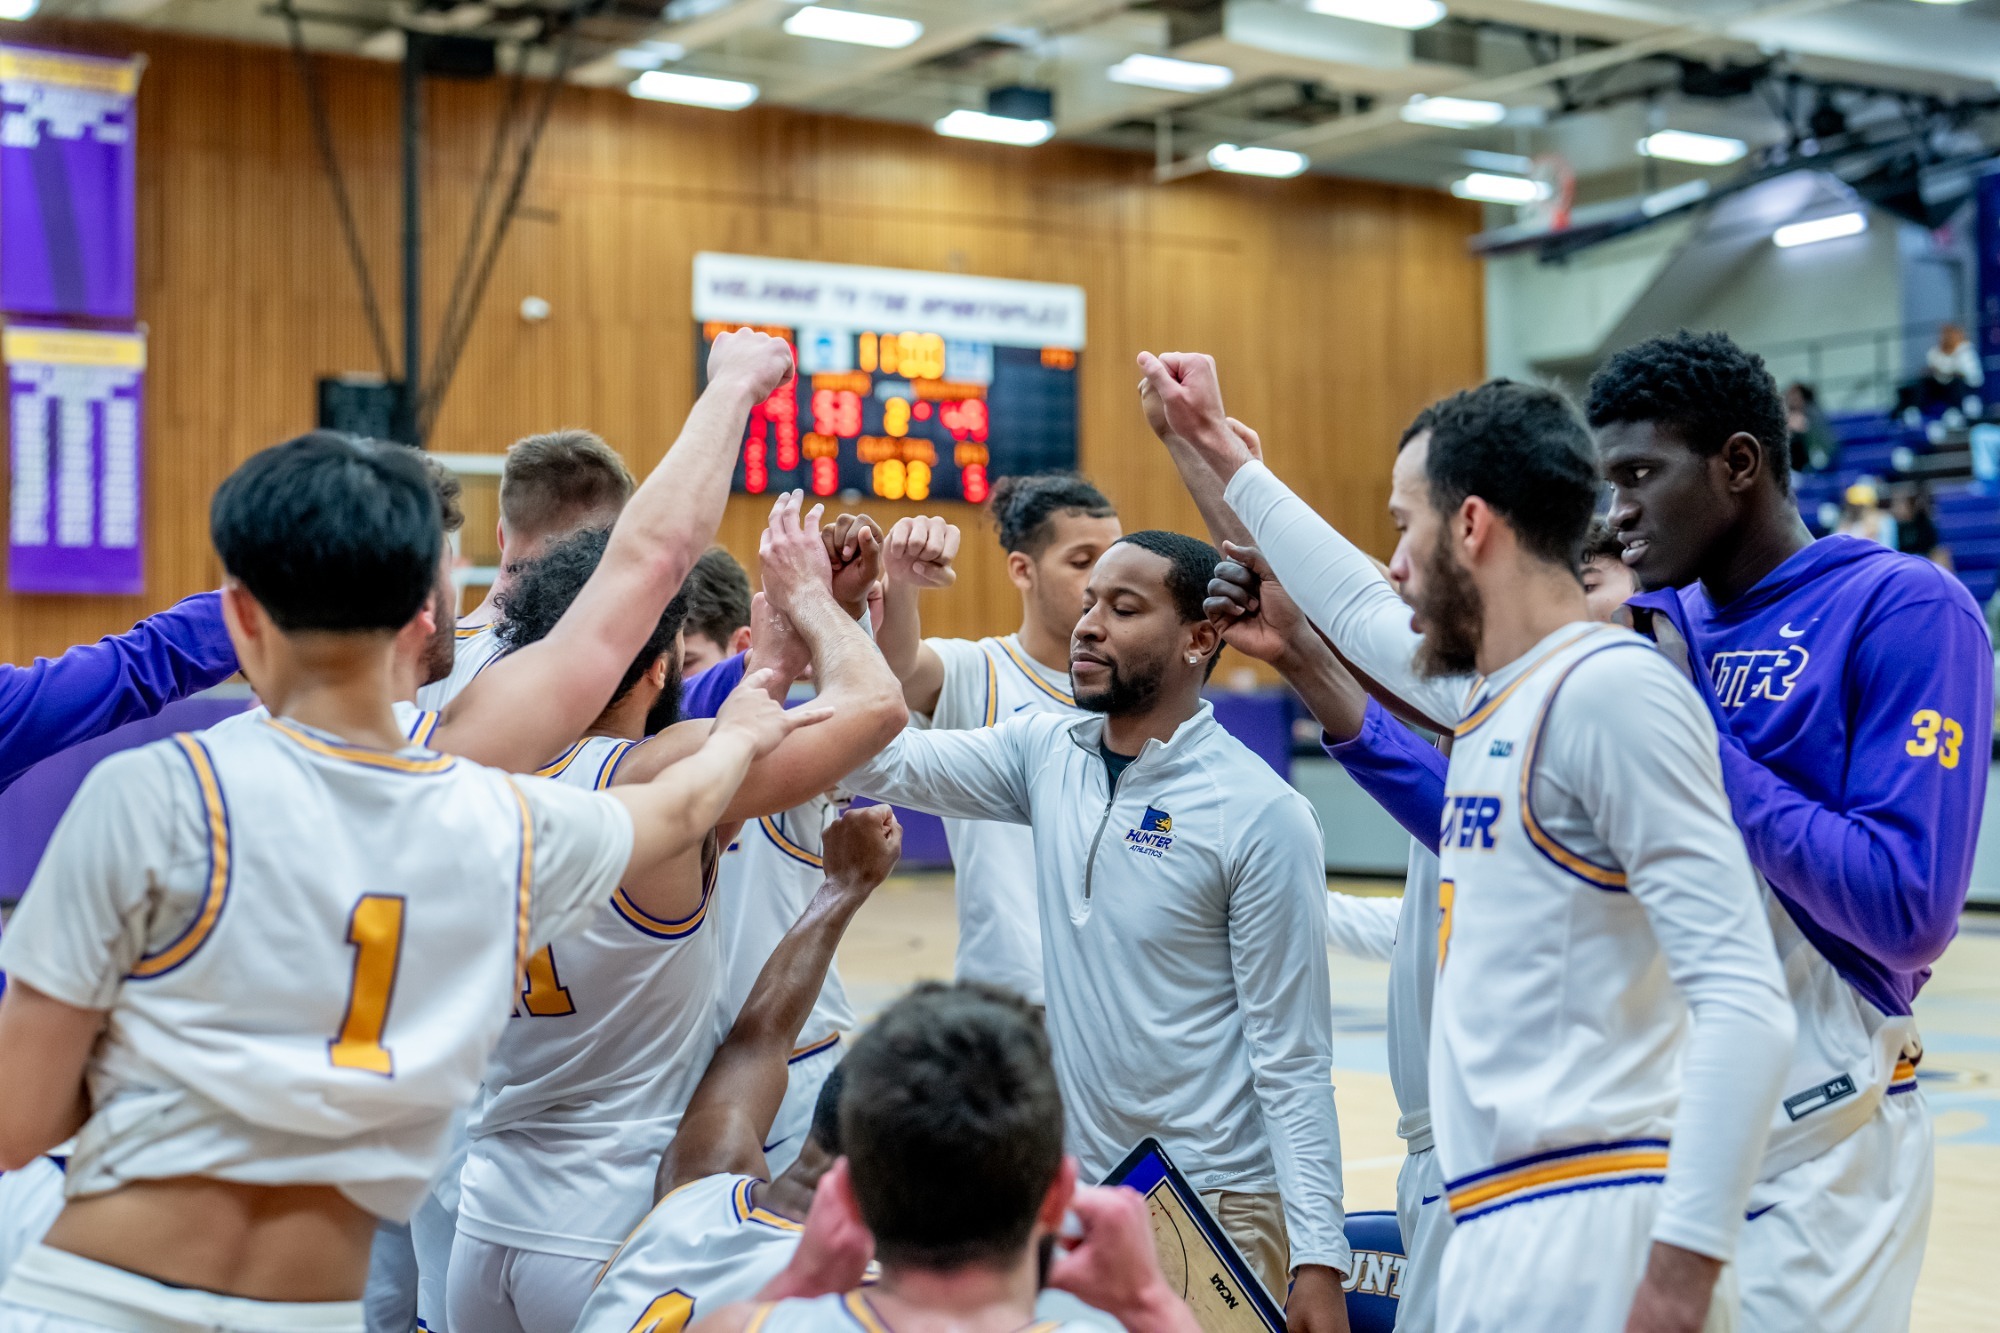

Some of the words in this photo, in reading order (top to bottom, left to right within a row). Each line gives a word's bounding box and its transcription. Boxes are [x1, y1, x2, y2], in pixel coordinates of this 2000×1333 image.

[1905, 709, 1964, 769] 33
[1125, 828, 1173, 850] HUNTER
[1128, 844, 1163, 858] ATHLETICS
[327, 891, 408, 1079] 1
[1827, 1081, 1849, 1096] XL
[1209, 1272, 1240, 1311] NCAA
